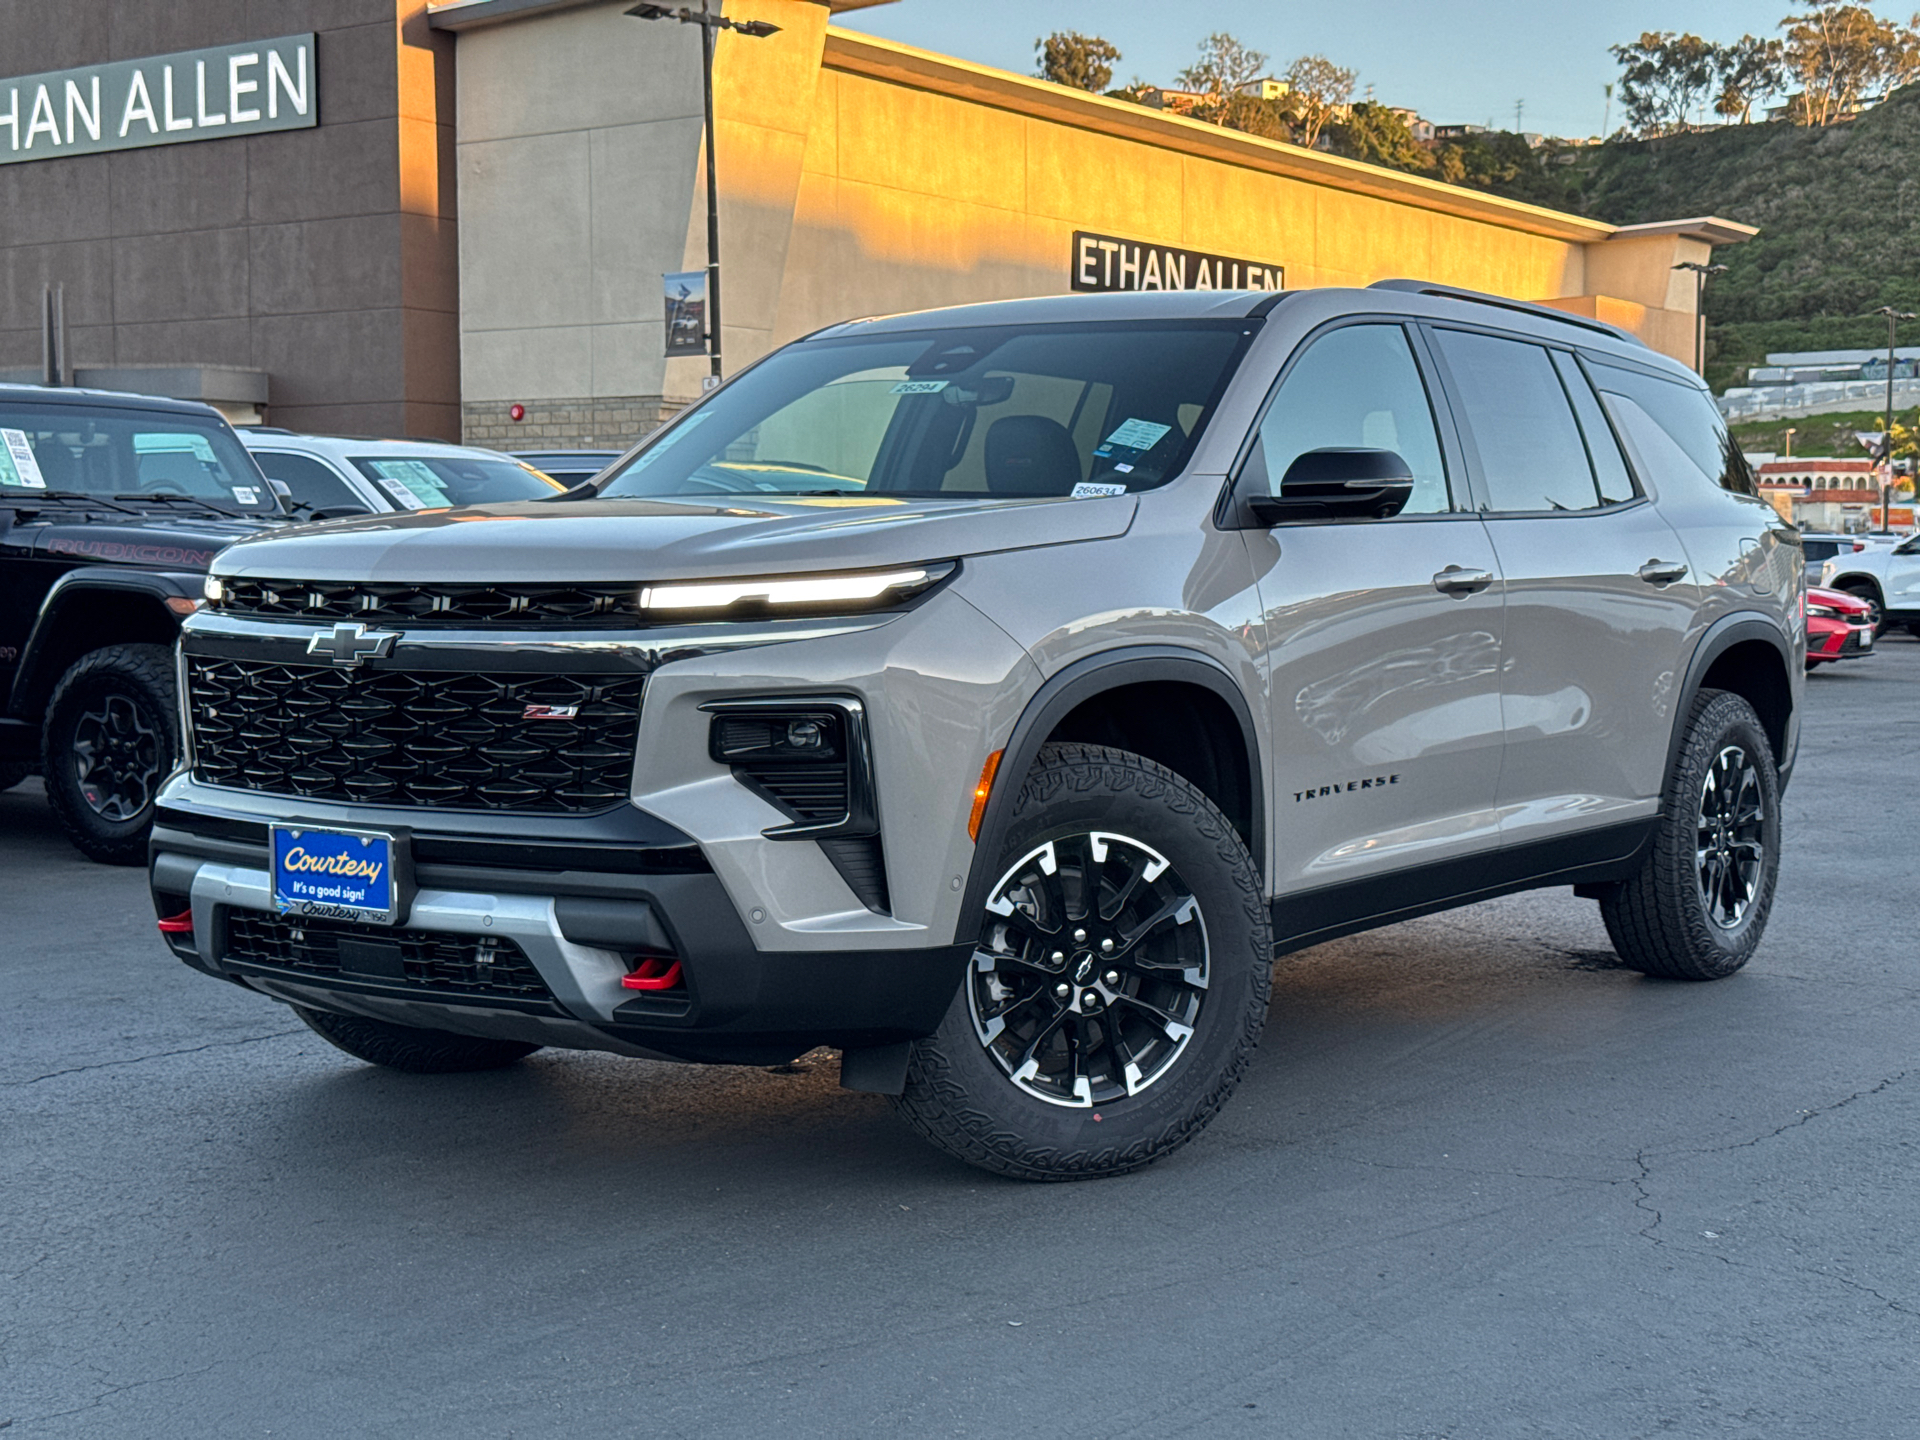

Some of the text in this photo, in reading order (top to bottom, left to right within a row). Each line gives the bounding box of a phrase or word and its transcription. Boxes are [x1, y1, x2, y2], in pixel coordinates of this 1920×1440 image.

[118, 45, 308, 138] ALLEN
[1079, 237, 1186, 290] ETHAN
[896, 383, 939, 393] 26294
[1076, 486, 1117, 496] 260634
[48, 538, 215, 566] RUBICON
[522, 704, 579, 720] Z71
[1293, 773, 1401, 803] TRAVERSE
[284, 846, 383, 885] Courtesy
[293, 880, 365, 902] It's a good sign!
[301, 900, 361, 923] Courtesy
